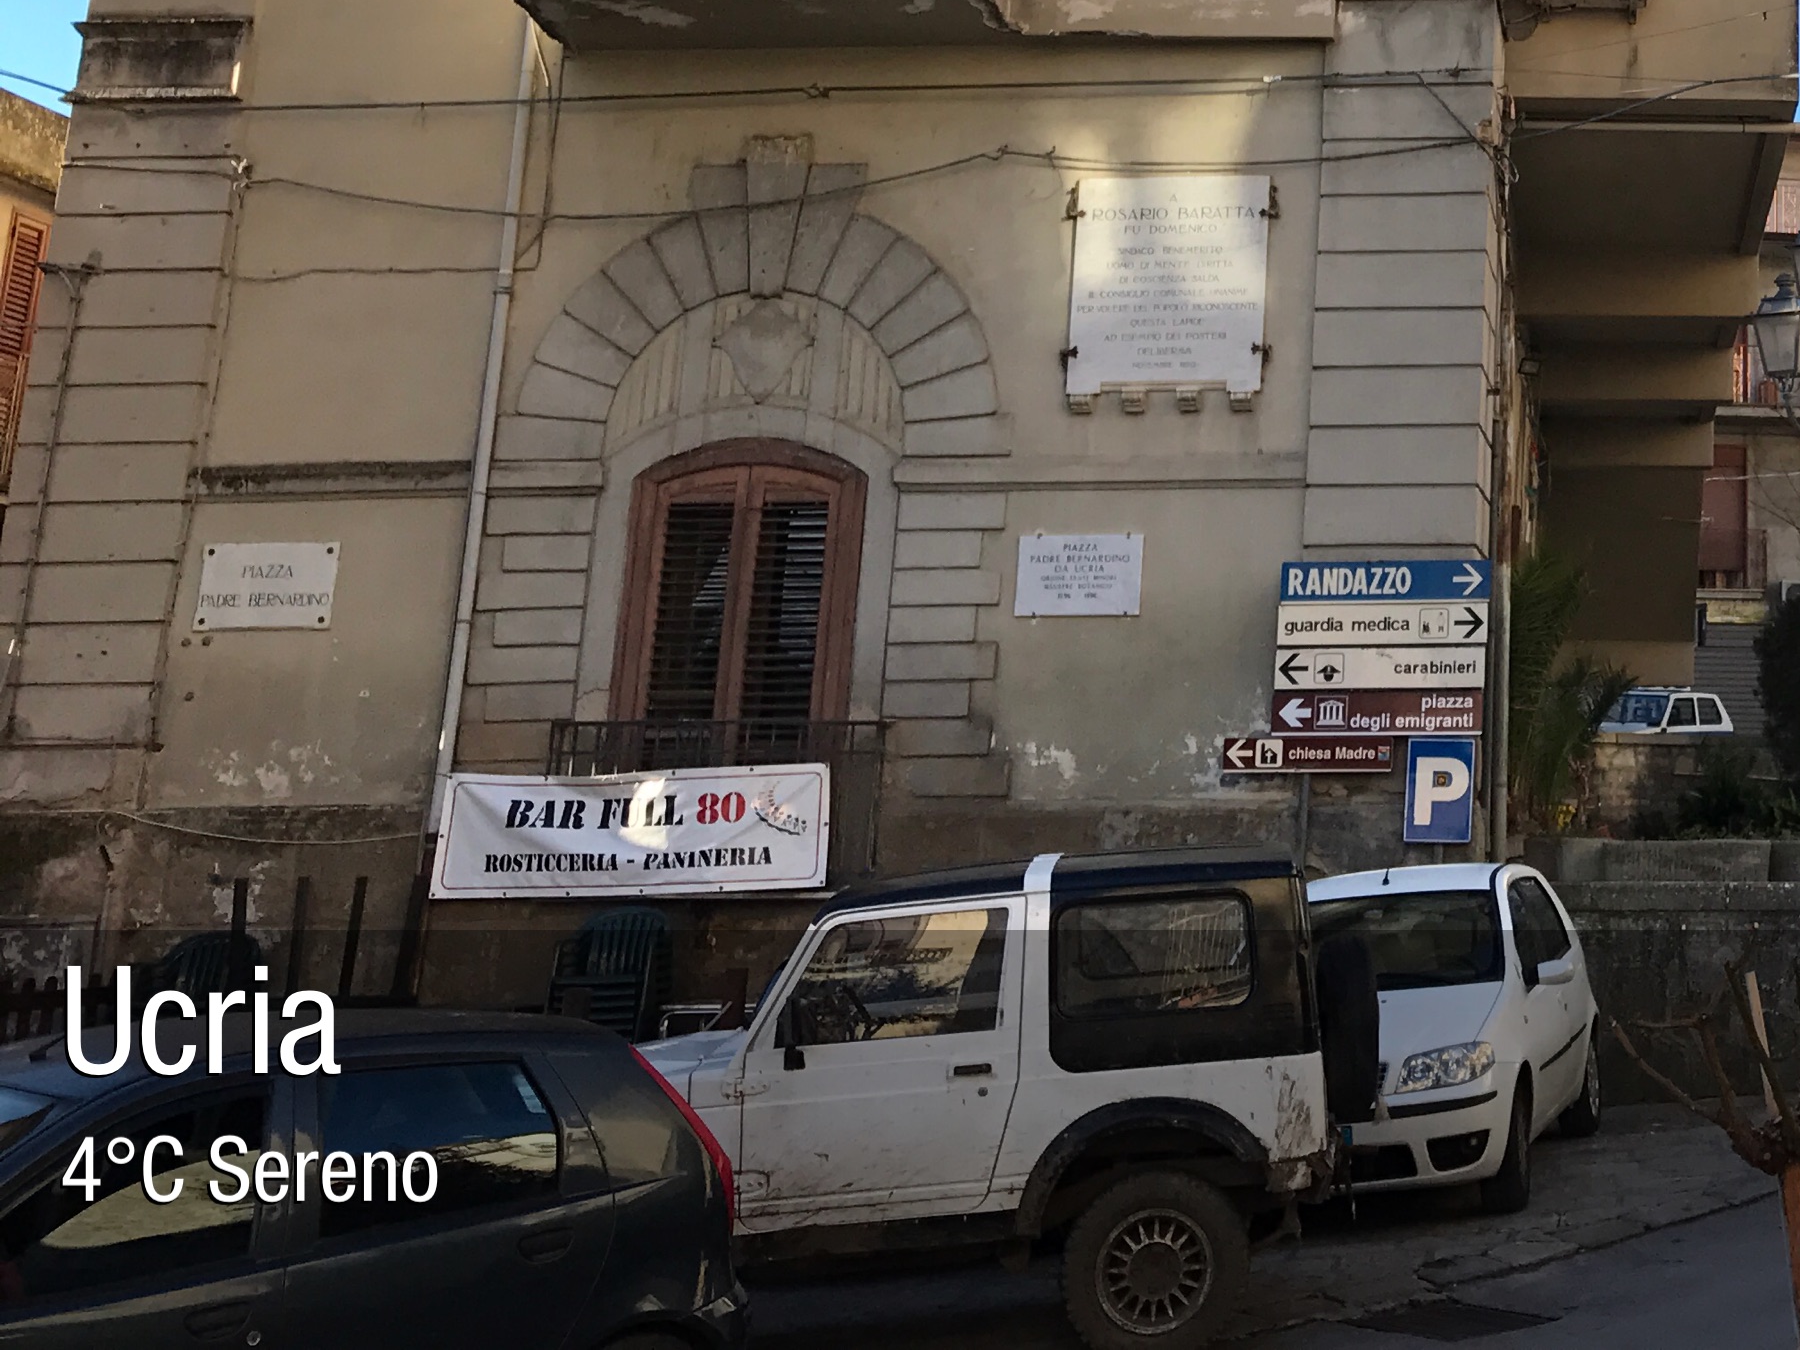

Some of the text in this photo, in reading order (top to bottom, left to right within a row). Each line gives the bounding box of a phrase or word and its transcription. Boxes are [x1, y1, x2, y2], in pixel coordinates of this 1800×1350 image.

[1169, 193, 1178, 203] A
[1092, 206, 1255, 221] ROSARIO BARATTA
[1124, 223, 1218, 235] FU DOMENICO
[1063, 543, 1098, 552] PIAZZA
[1030, 554, 1061, 563] PADRE
[242, 564, 293, 579] PIAZZA
[1287, 566, 1412, 596] RANDAZZO
[200, 592, 330, 608] PADRE BERNARDINO
[1284, 616, 1410, 636] guardia medica
[1393, 660, 1477, 675] carabinieri
[1421, 694, 1474, 713] piazza
[1350, 713, 1474, 732] degli emigranti
[1288, 746, 1376, 761] chiesa Madre
[1413, 757, 1470, 826] P
[504, 791, 747, 830] BAR FULL 80
[484, 852, 619, 873] ROSTICCERIA
[643, 846, 773, 871] PANINERIA
